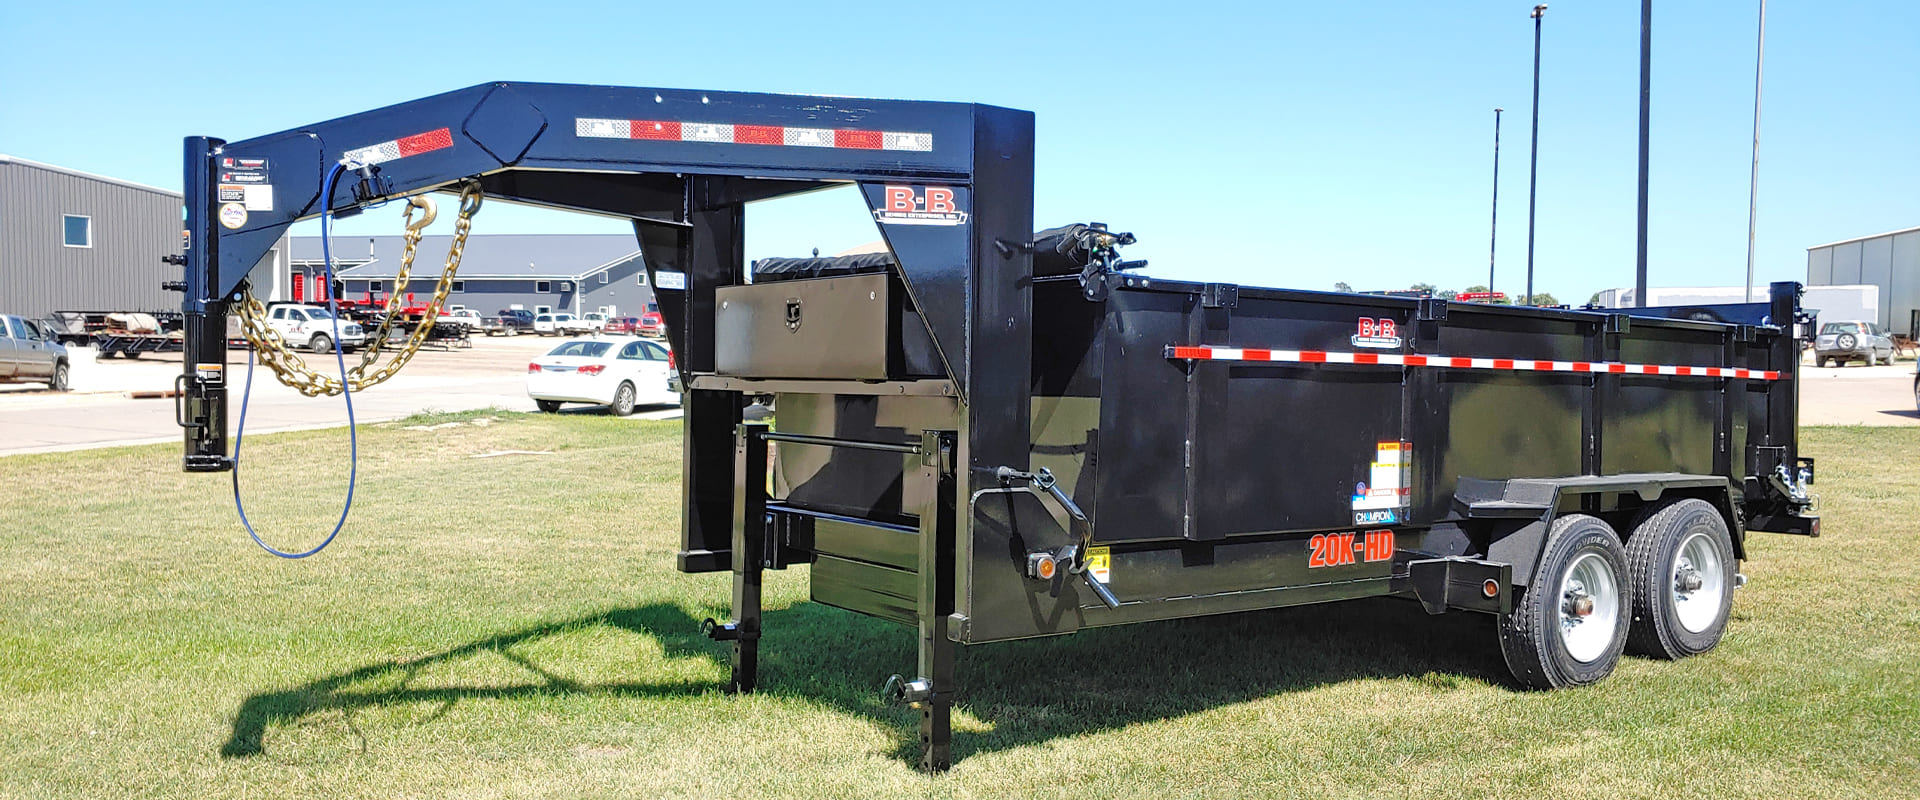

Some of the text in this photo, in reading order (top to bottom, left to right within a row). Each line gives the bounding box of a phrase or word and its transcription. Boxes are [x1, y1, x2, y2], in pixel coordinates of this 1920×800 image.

[886, 186, 955, 212] B-B
[1358, 316, 1396, 338] B-B
[1355, 511, 1392, 522] CHAMPION
[1309, 529, 1393, 568] 20K-HD
